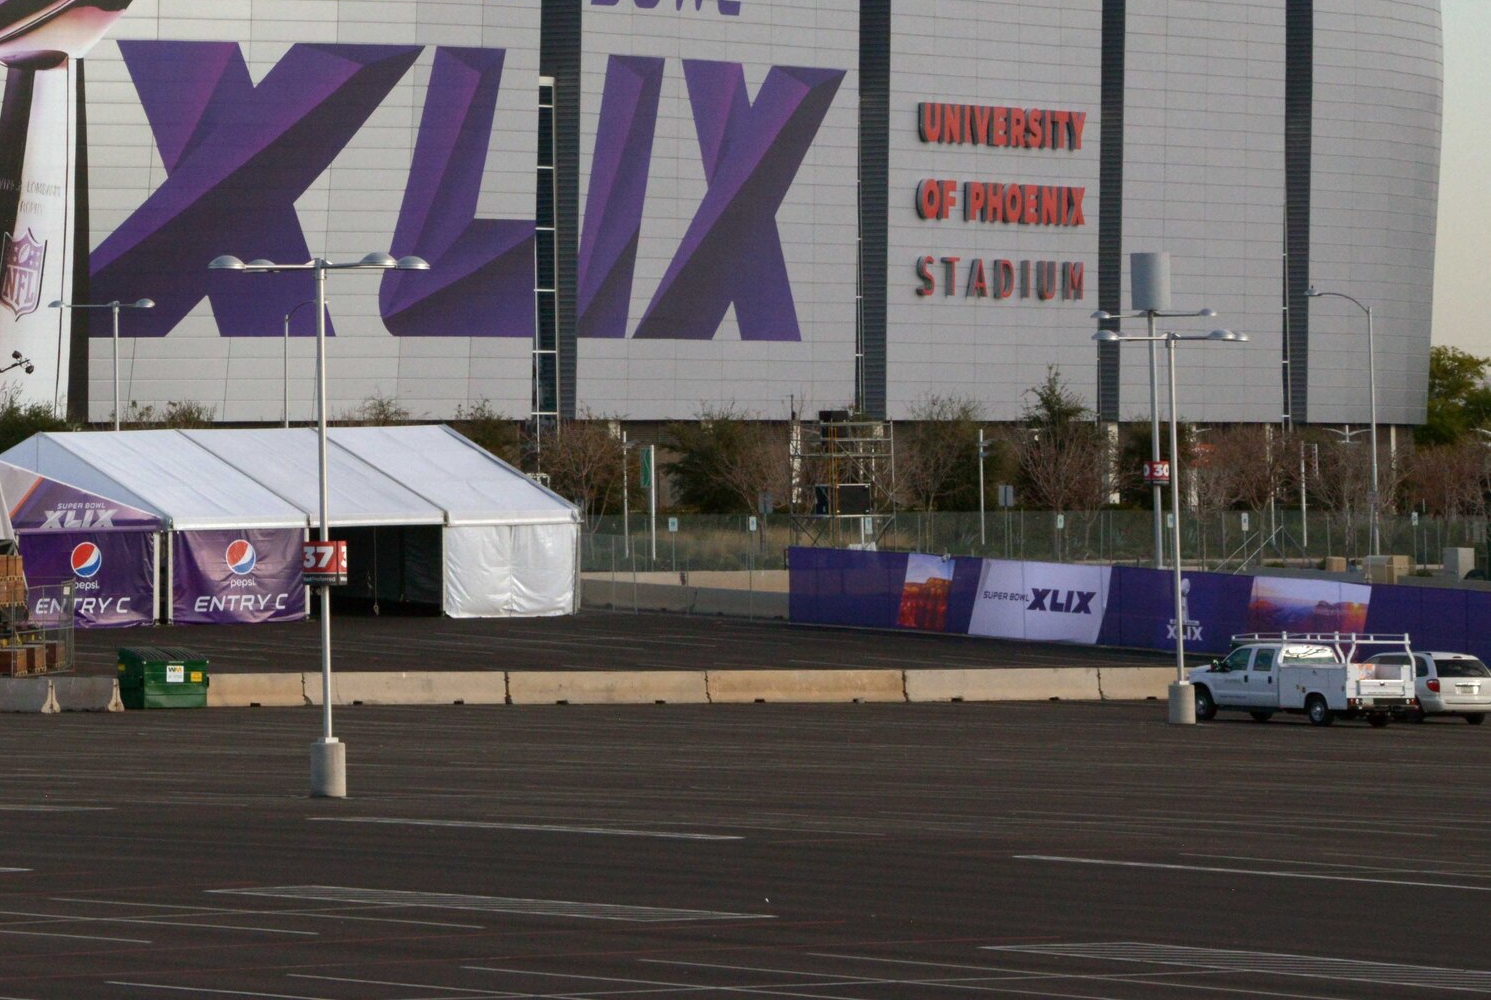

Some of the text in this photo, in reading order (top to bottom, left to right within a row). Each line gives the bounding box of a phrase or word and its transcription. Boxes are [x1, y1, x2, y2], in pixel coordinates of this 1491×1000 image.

[918, 102, 1086, 150] UNIVERSITY
[88, 39, 847, 342] XLIX
[916, 178, 1085, 226] OF PHOENIX
[2, 266, 36, 307] NFL
[916, 255, 1085, 301] STADIUM
[1153, 463, 1170, 477] 30
[57, 502, 83, 510] SUPER
[39, 509, 118, 528] XLIX
[303, 546, 334, 568] 37
[230, 577, 255, 588] pepsi
[35, 597, 131, 614] ENTRY C
[194, 593, 289, 612] ENTRY C
[983, 588, 1097, 614] SUPER BOWL XLIX
